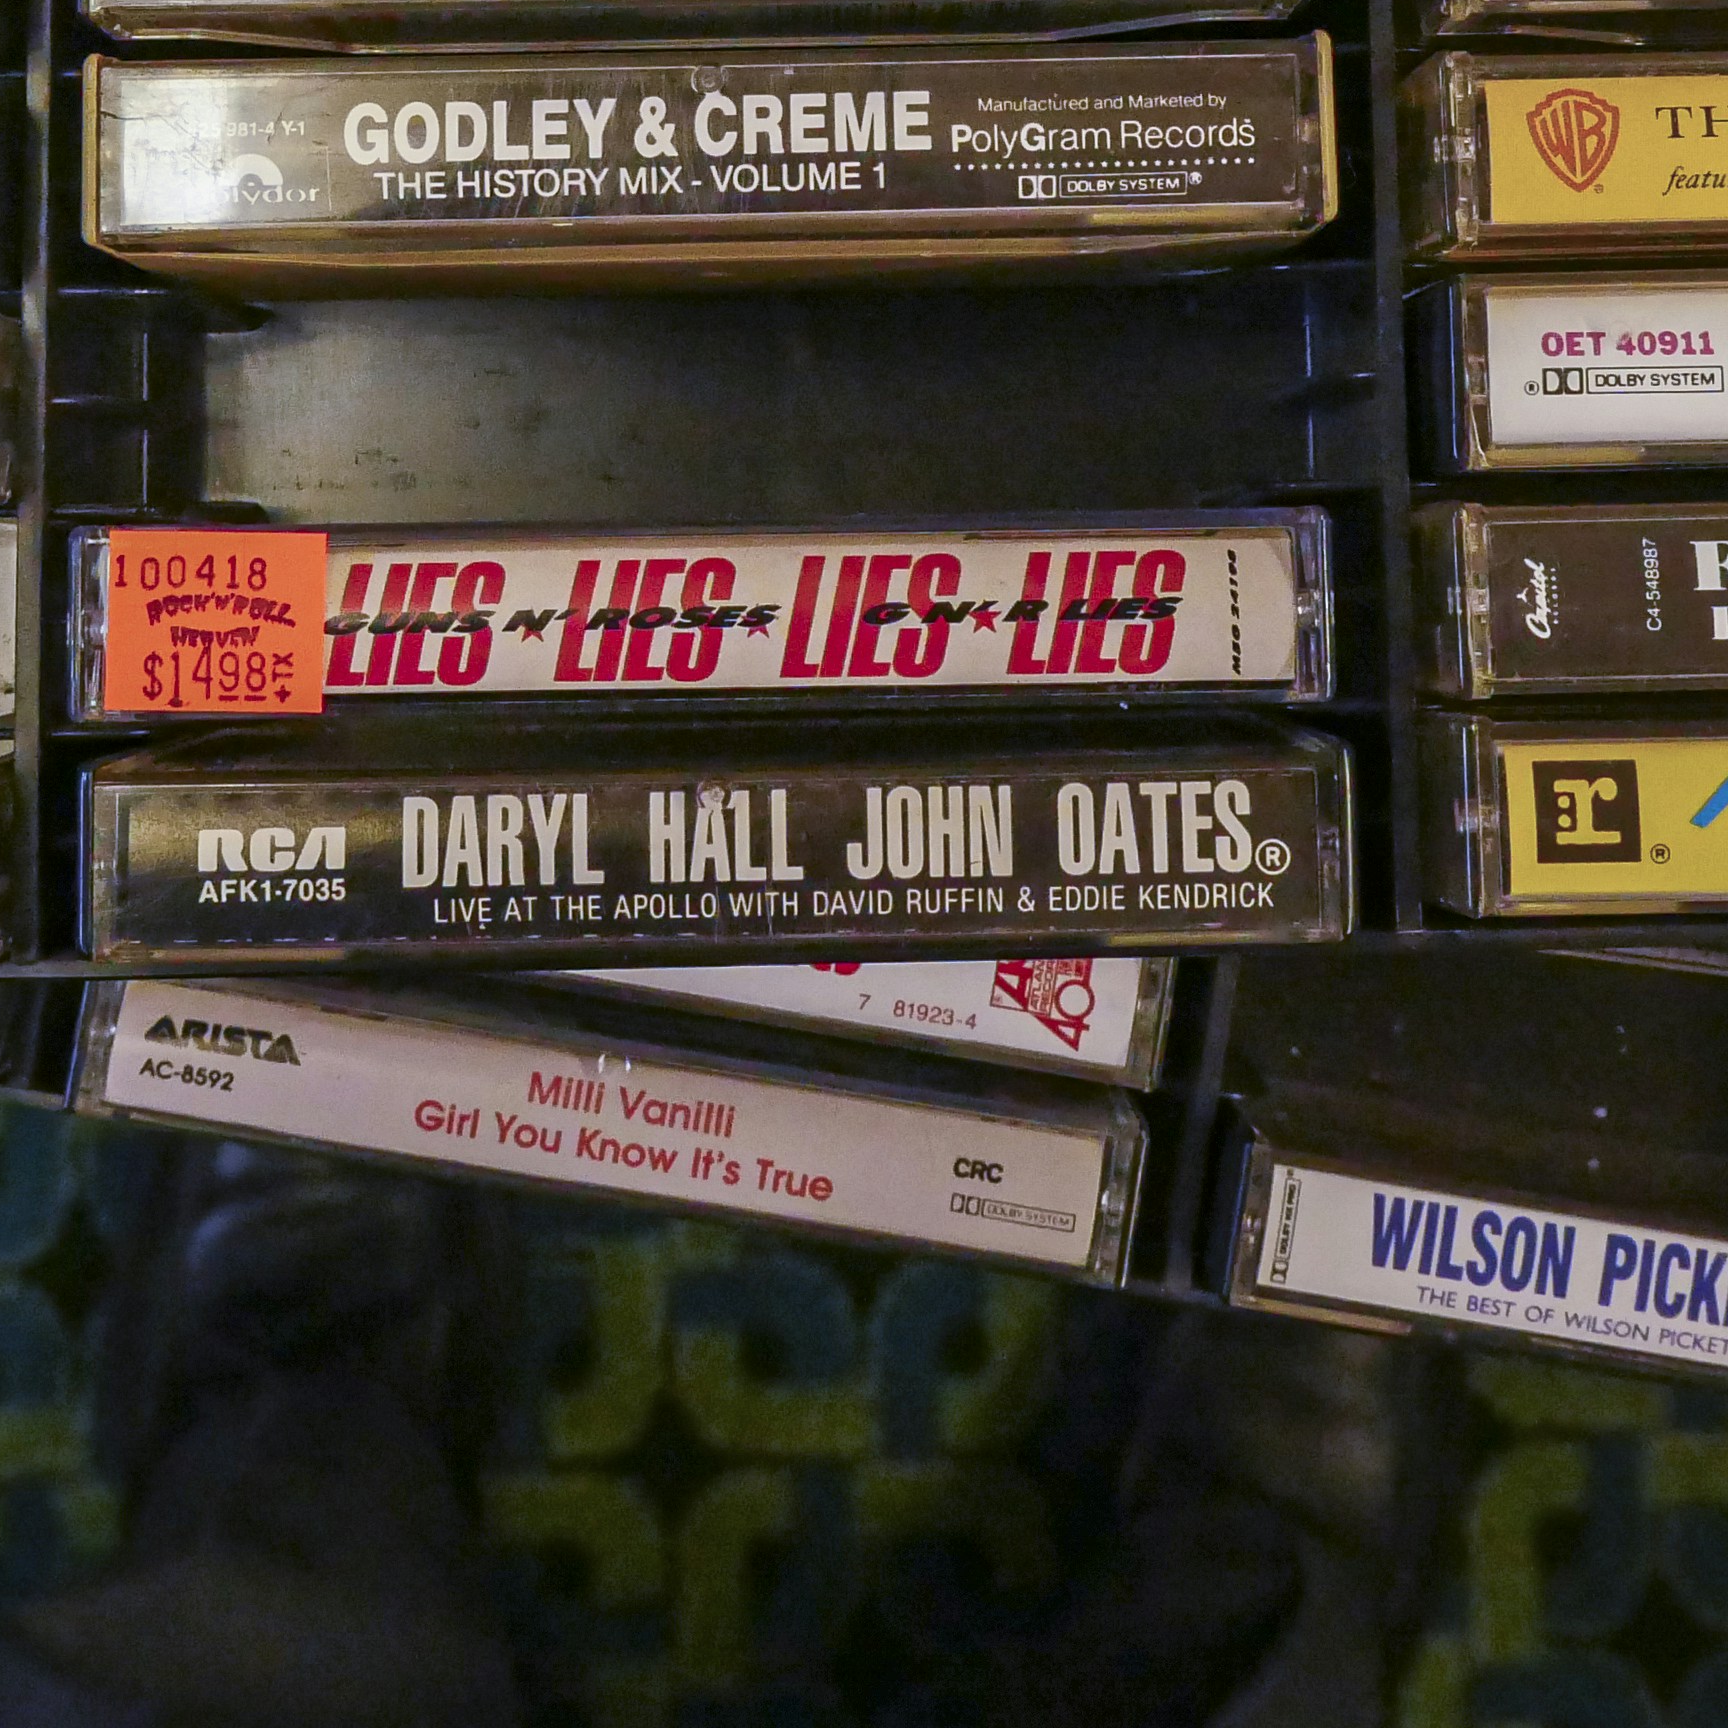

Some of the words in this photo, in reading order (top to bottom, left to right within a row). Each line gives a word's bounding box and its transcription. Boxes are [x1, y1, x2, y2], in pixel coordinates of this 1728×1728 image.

[342, 97, 618, 166] GODLEY
[634, 95, 680, 158] &
[694, 90, 935, 161] CREME
[950, 122, 1119, 161] PolyGram
[1120, 119, 1257, 150] Records
[1642, 536, 1661, 633] C4-548987
[401, 793, 605, 890] DARYL
[648, 788, 804, 885] HALL
[846, 784, 1015, 881] JOHN
[1057, 779, 1254, 877] OATES
[198, 878, 346, 904] AFK1-7035
[138, 1057, 235, 1092] AC-8592
[527, 1071, 606, 1115] Milli
[618, 1086, 737, 1138] Vanilli
[413, 1098, 480, 1146] Girl
[494, 1108, 562, 1154] You
[574, 1124, 679, 1177] Know
[690, 1146, 742, 1187] It's
[755, 1157, 834, 1202] True
[1371, 1192, 1577, 1300] WILSON
[1415, 1284, 1459, 1311] THE
[1465, 1292, 1515, 1321] BEST
[1523, 1300, 1556, 1326] OF
[1562, 1310, 1650, 1344] WILSON
